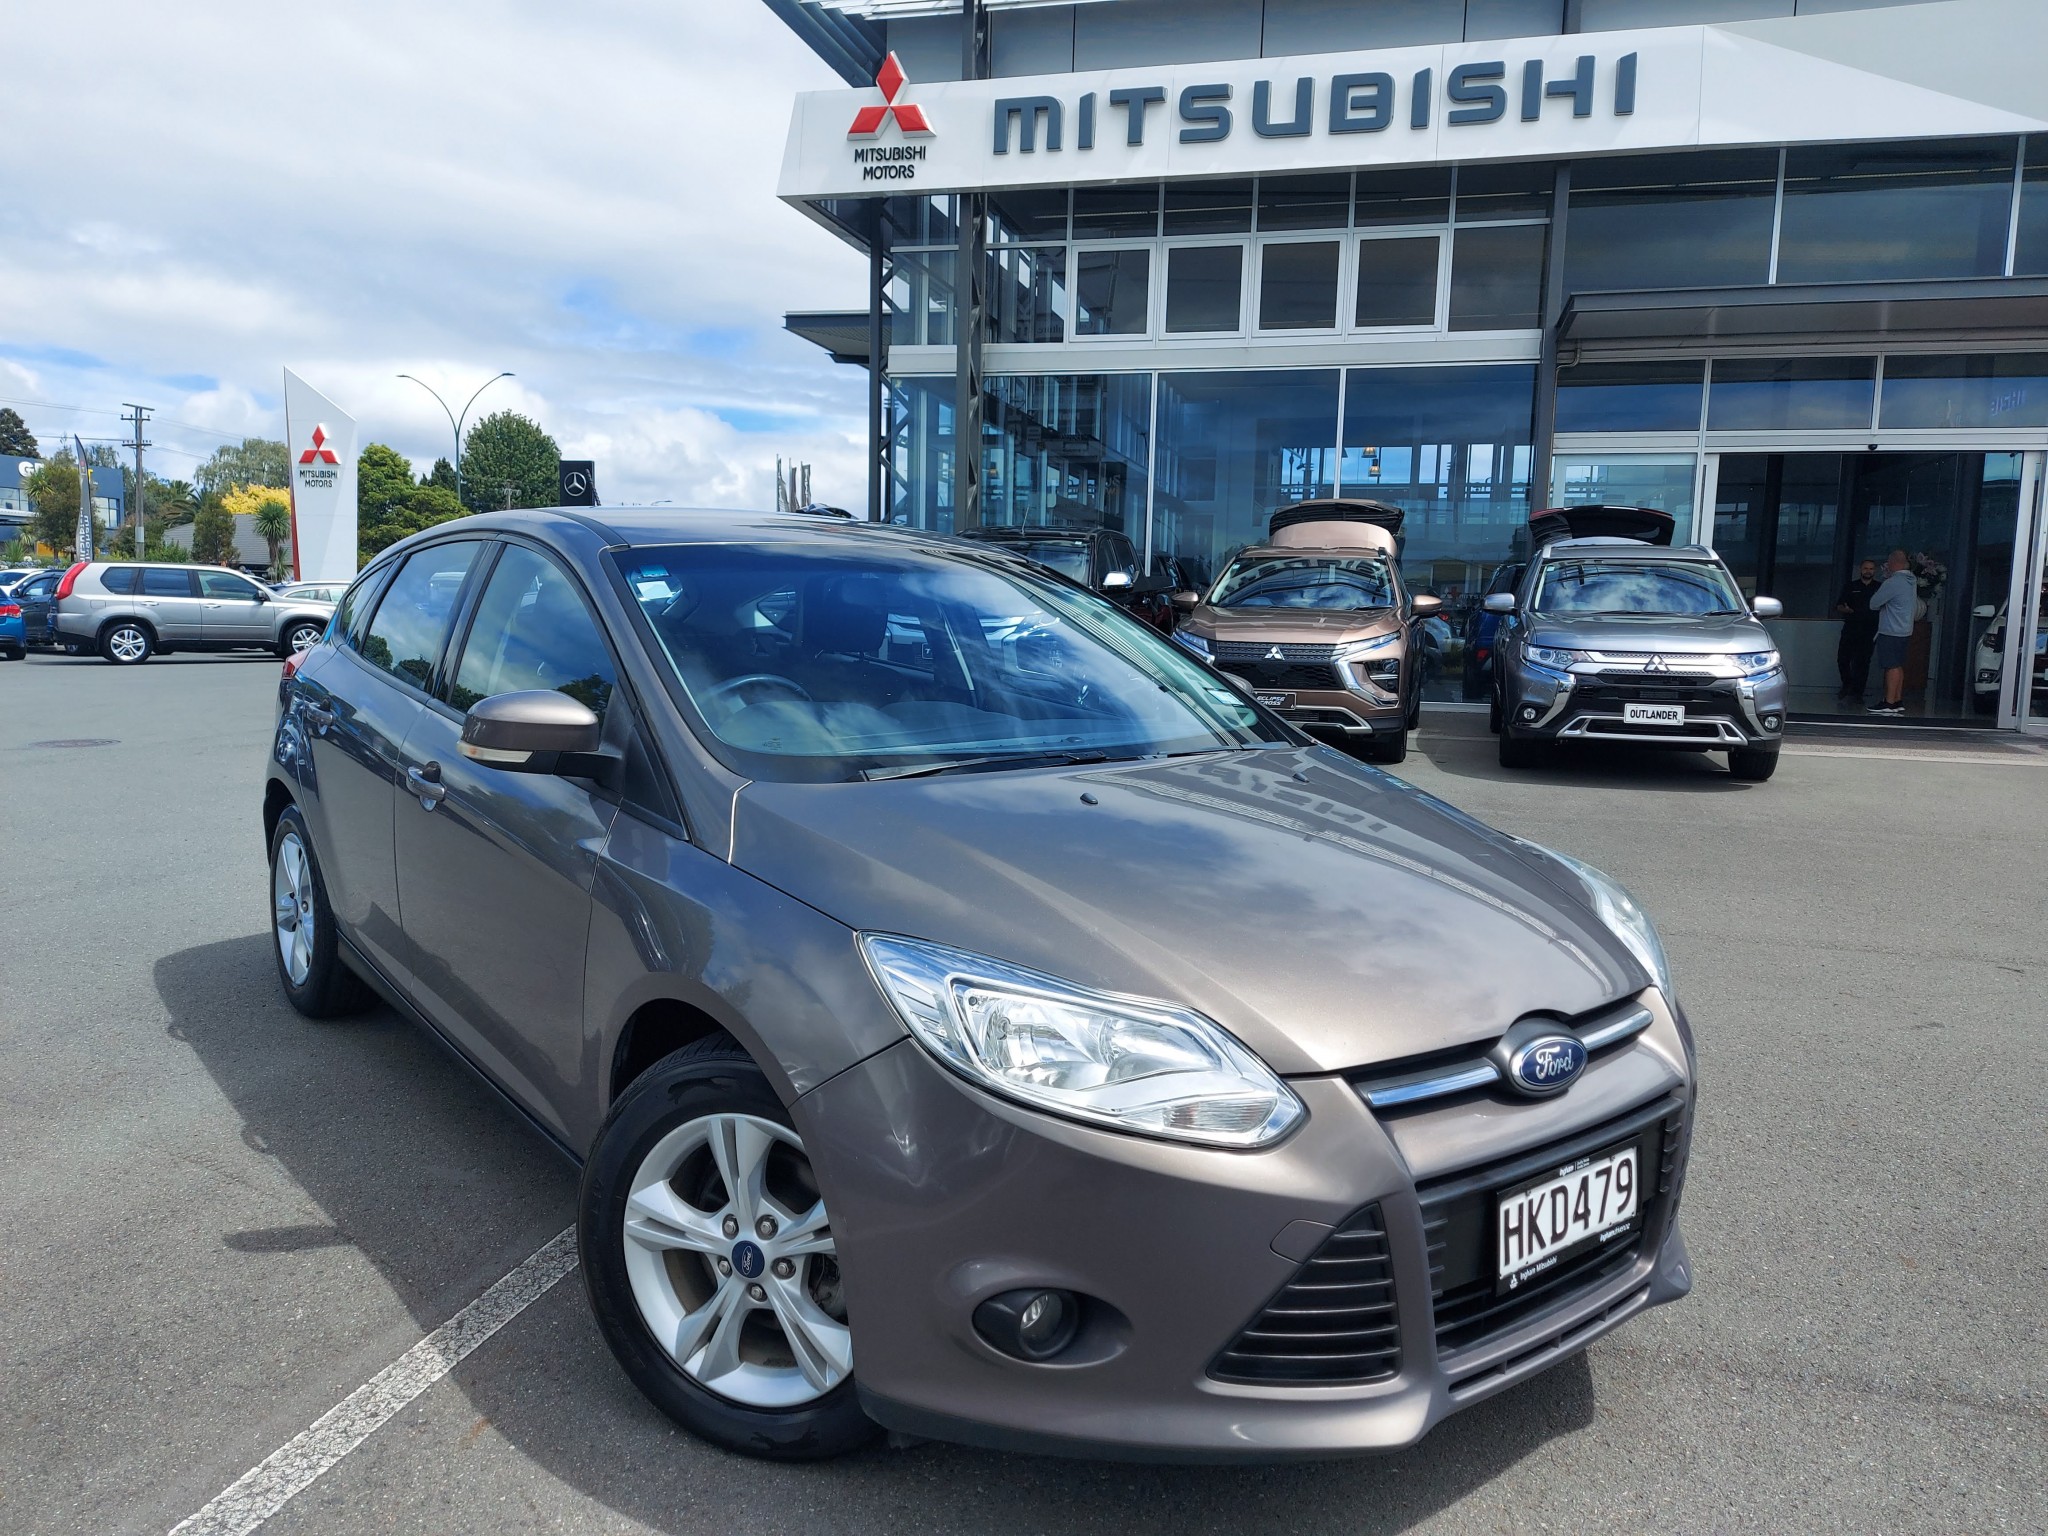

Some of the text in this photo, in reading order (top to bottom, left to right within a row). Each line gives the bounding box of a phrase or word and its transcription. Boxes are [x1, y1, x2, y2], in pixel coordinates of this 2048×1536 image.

[993, 51, 1638, 155] MITSUBISHI
[854, 146, 926, 163] MITSUBISHI
[863, 164, 915, 180] MOTORS
[299, 470, 338, 479] MITSUBISHI
[305, 479, 333, 487] MOTORS
[1629, 709, 1678, 720] OUTLANDER
[1535, 1045, 1575, 1080] Ford
[1503, 1157, 1633, 1267] HKD479
[743, 1250, 752, 1270] Ford
